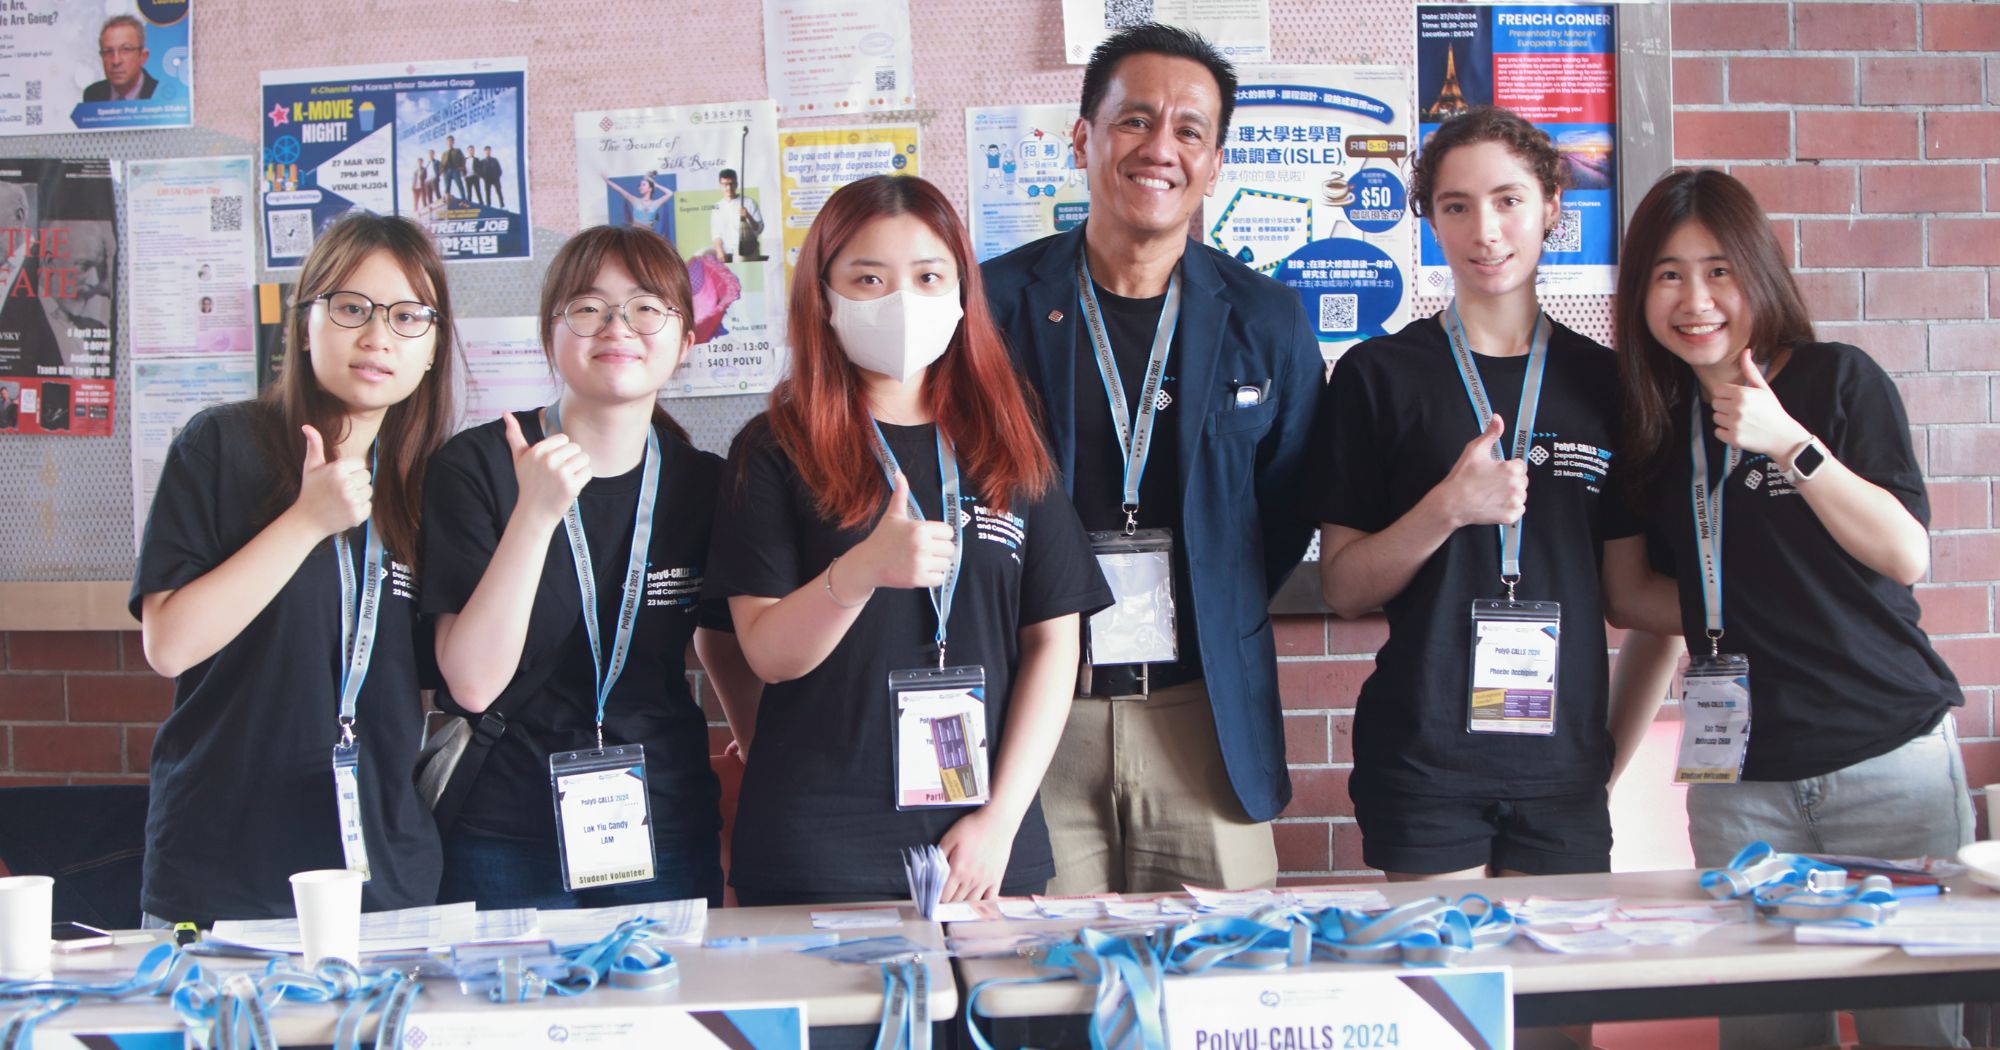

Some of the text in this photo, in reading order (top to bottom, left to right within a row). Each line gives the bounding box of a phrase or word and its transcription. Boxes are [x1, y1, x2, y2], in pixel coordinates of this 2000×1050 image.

[11, 11, 58, 26] Are Going?
[1498, 13, 1611, 26] FRENCH CORNER
[1509, 29, 1550, 38] Presented
[1552, 29, 1562, 39] by
[1563, 29, 1586, 37] Minor
[1517, 38, 1588, 49] European Studies
[365, 83, 392, 91] Korean
[394, 81, 416, 89] Minor
[417, 80, 448, 89] Student
[449, 79, 475, 88] Group
[293, 98, 354, 122] K-MOVIE
[302, 121, 348, 143] NIGHT!
[1239, 126, 1342, 142] 理大學生學習
[600, 135, 680, 152] The Sound of
[332, 157, 386, 167] 27 MAR WED
[657, 153, 727, 170] Silk Route
[788, 148, 890, 163] Do you eat when you feel
[788, 160, 891, 176] angry, happy, depressed,
[800, 173, 818, 183] hurt,
[821, 173, 830, 182] or
[332, 182, 388, 192] VENUE: HJ304
[1361, 186, 1391, 209] $50
[479, 219, 509, 232] JOB
[0, 227, 72, 258] THE
[73, 328, 91, 338] April
[708, 341, 769, 353] 12:00 13:00
[708, 356, 762, 368] S401 POLYU
[1150, 359, 1162, 377] 2024
[37, 365, 110, 376] Tsuen Wan Town Hall
[1096, 334, 1106, 350] and
[1101, 349, 1123, 409] Communication
[1455, 335, 1473, 376] Department
[1471, 381, 1484, 408] English
[1516, 429, 1527, 447] 2024
[1553, 441, 1598, 456] PolyU-CALLS
[1562, 470, 1583, 479] March
[1696, 484, 1705, 500] 2024
[577, 542, 586, 560] and
[581, 559, 596, 626] Communication
[621, 569, 641, 630] PolyU-CALLS 2024
[615, 794, 630, 802] 2024
[583, 820, 629, 834] Lok Yiu Candy
[601, 836, 615, 845] LAM
[579, 868, 647, 885] Student Volunteer
[1196, 1023, 1400, 1050] PolyU-CALLS 2024
